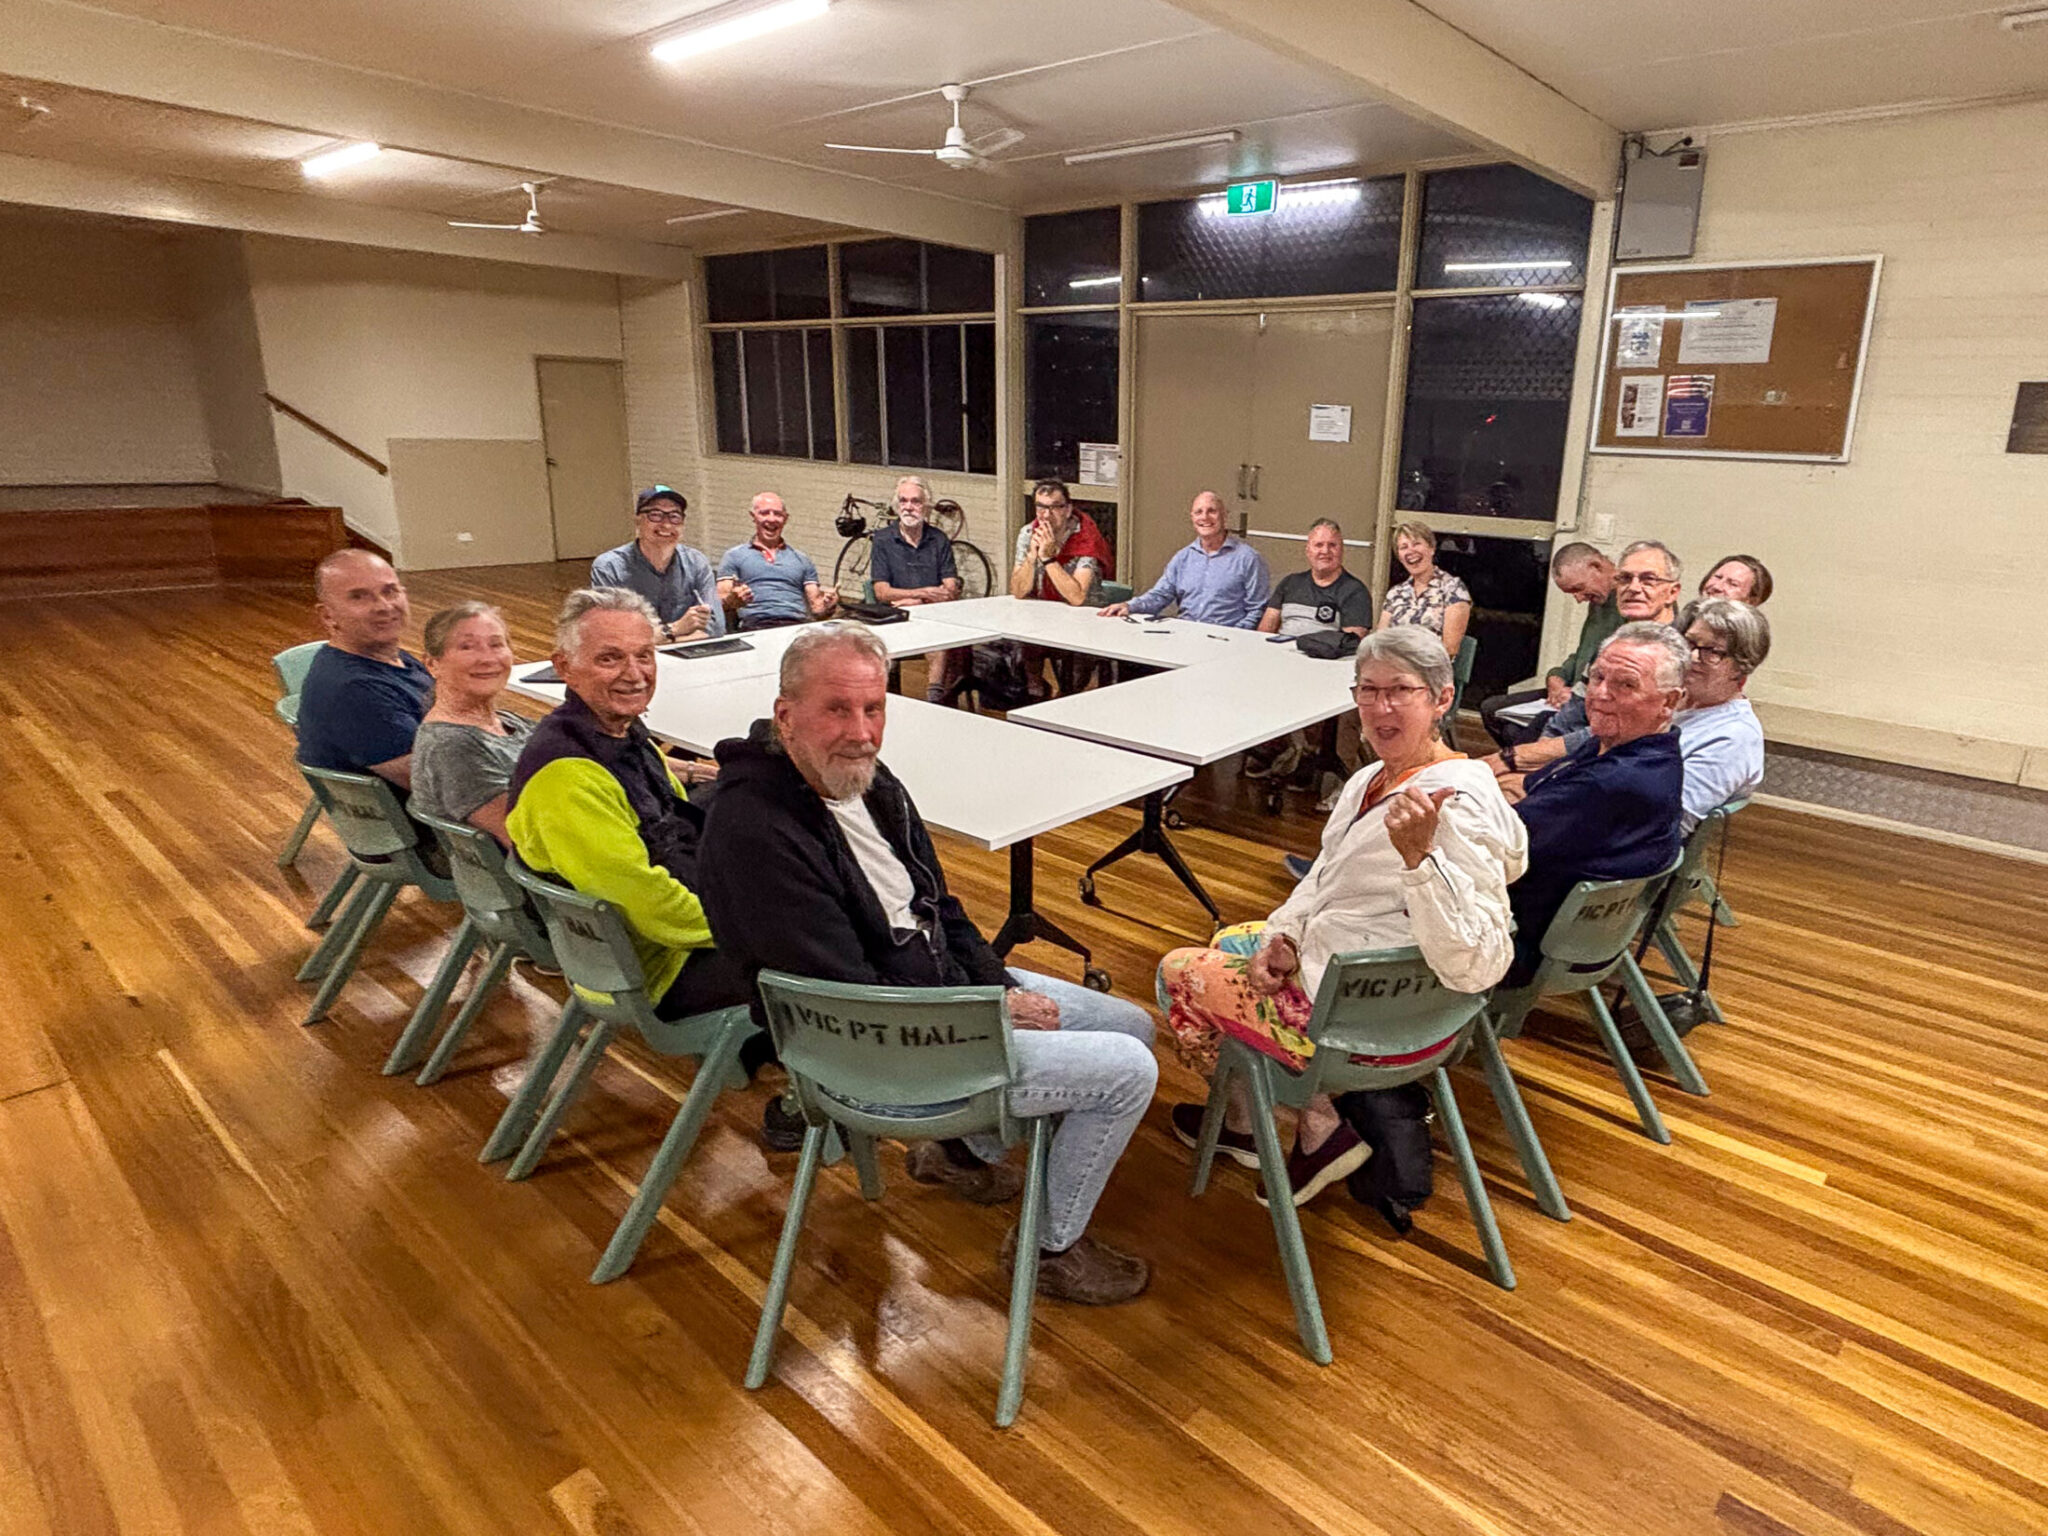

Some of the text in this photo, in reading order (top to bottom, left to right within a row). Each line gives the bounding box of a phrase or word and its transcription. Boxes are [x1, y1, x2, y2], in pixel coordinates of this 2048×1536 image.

[1343, 978, 1388, 998] VIC
[1391, 974, 1429, 998] PT
[795, 1002, 842, 1036] VIC
[848, 1019, 889, 1045] PT
